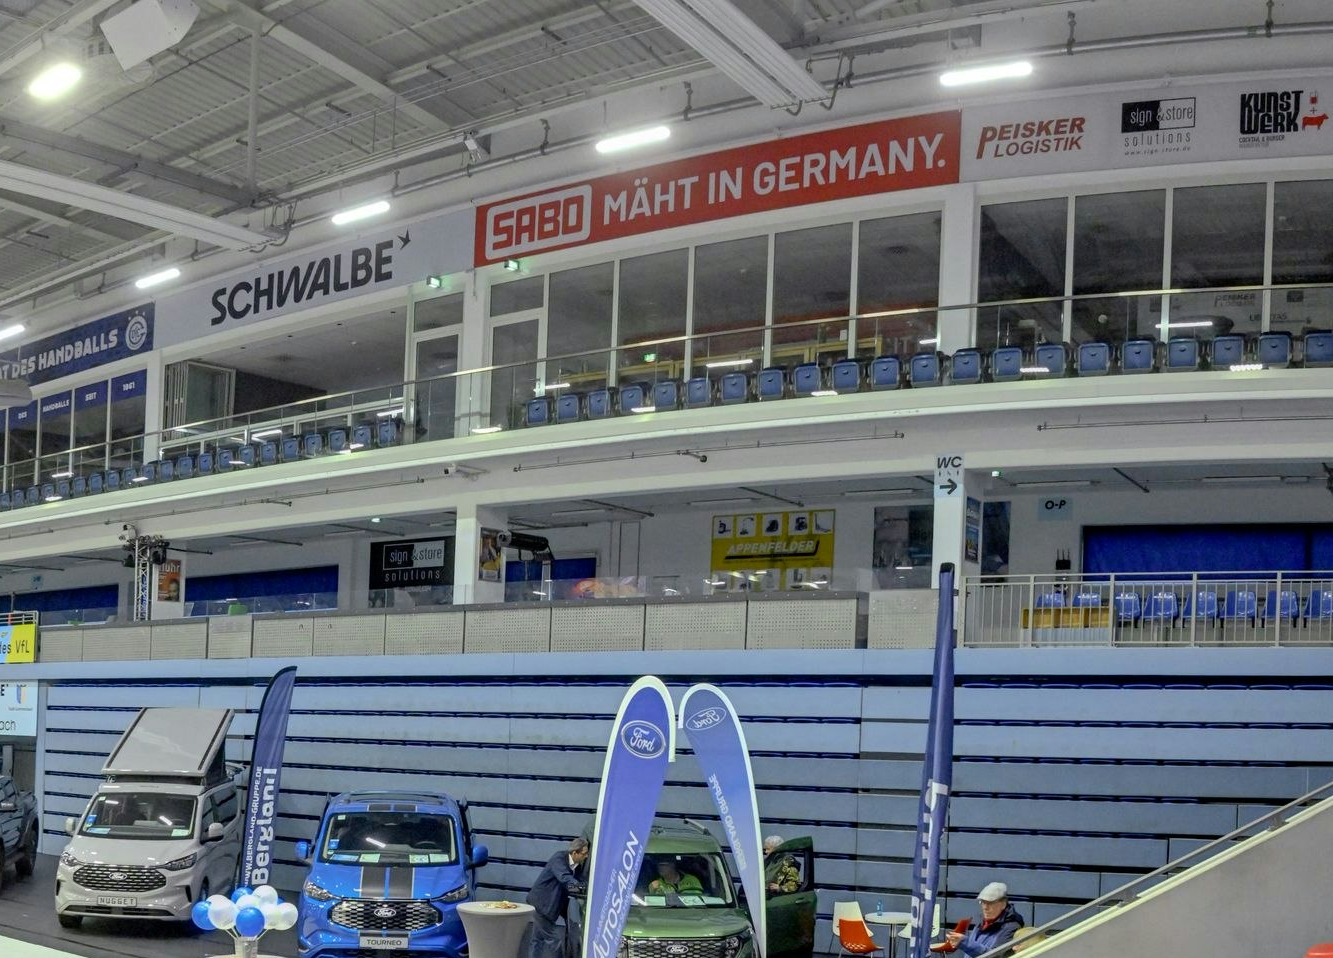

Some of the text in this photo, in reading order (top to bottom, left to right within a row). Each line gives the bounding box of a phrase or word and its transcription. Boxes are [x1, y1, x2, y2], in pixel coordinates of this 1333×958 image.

[1240, 91, 1304, 114] KUNST
[1130, 109, 1152, 126] sign
[1240, 108, 1299, 135] WERK
[977, 117, 1086, 160] PEISKER
[1124, 132, 1191, 147] solutions
[994, 136, 1083, 158] LOGISTIK
[603, 133, 946, 226] MÄHT IN GERMANY.
[492, 195, 585, 250] SABO
[210, 240, 393, 326] SCHWALBE
[12, 329, 118, 379] DES HANDBALLS
[85, 392, 97, 401] SEIT
[43, 400, 69, 413] HANDBALLS
[937, 456, 962, 469] WC
[1045, 499, 1066, 510] O-P
[727, 540, 816, 556] APPENFELDER
[390, 549, 408, 564] sign
[385, 569, 440, 582] solutions
[16, 640, 30, 653] VfL
[630, 727, 656, 751] Ford
[99, 897, 135, 906] NUGGET
